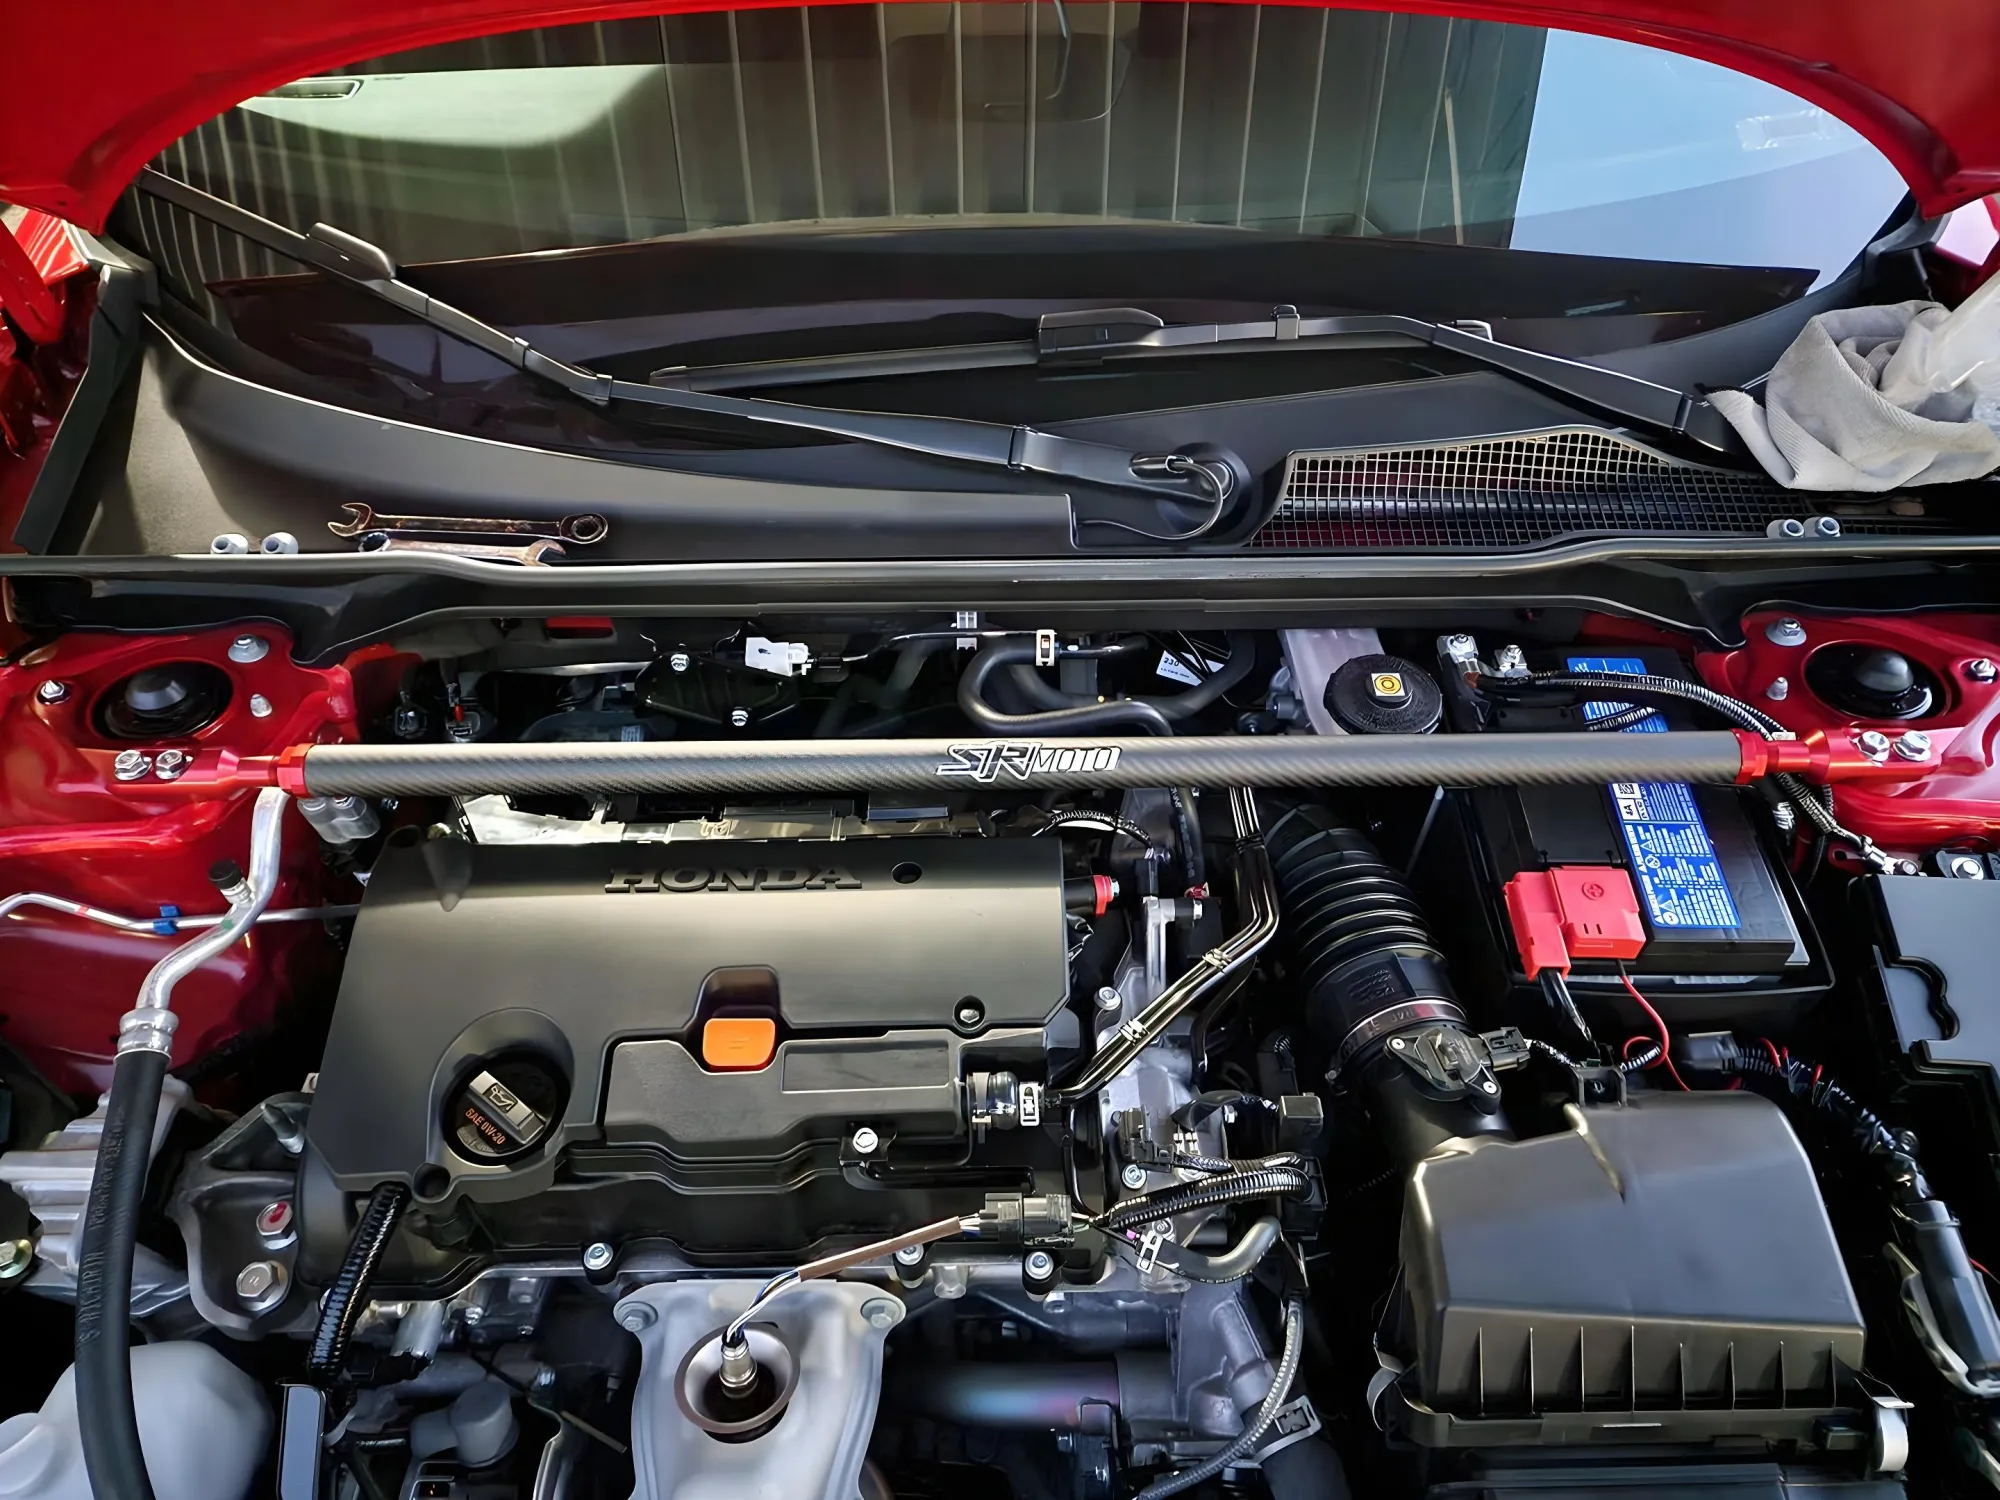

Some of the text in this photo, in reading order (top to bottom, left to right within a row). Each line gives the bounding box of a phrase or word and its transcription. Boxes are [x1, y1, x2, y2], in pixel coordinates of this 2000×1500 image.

[604, 865, 862, 893] HONDA
[465, 1108, 506, 1145] SAE 0W-20
